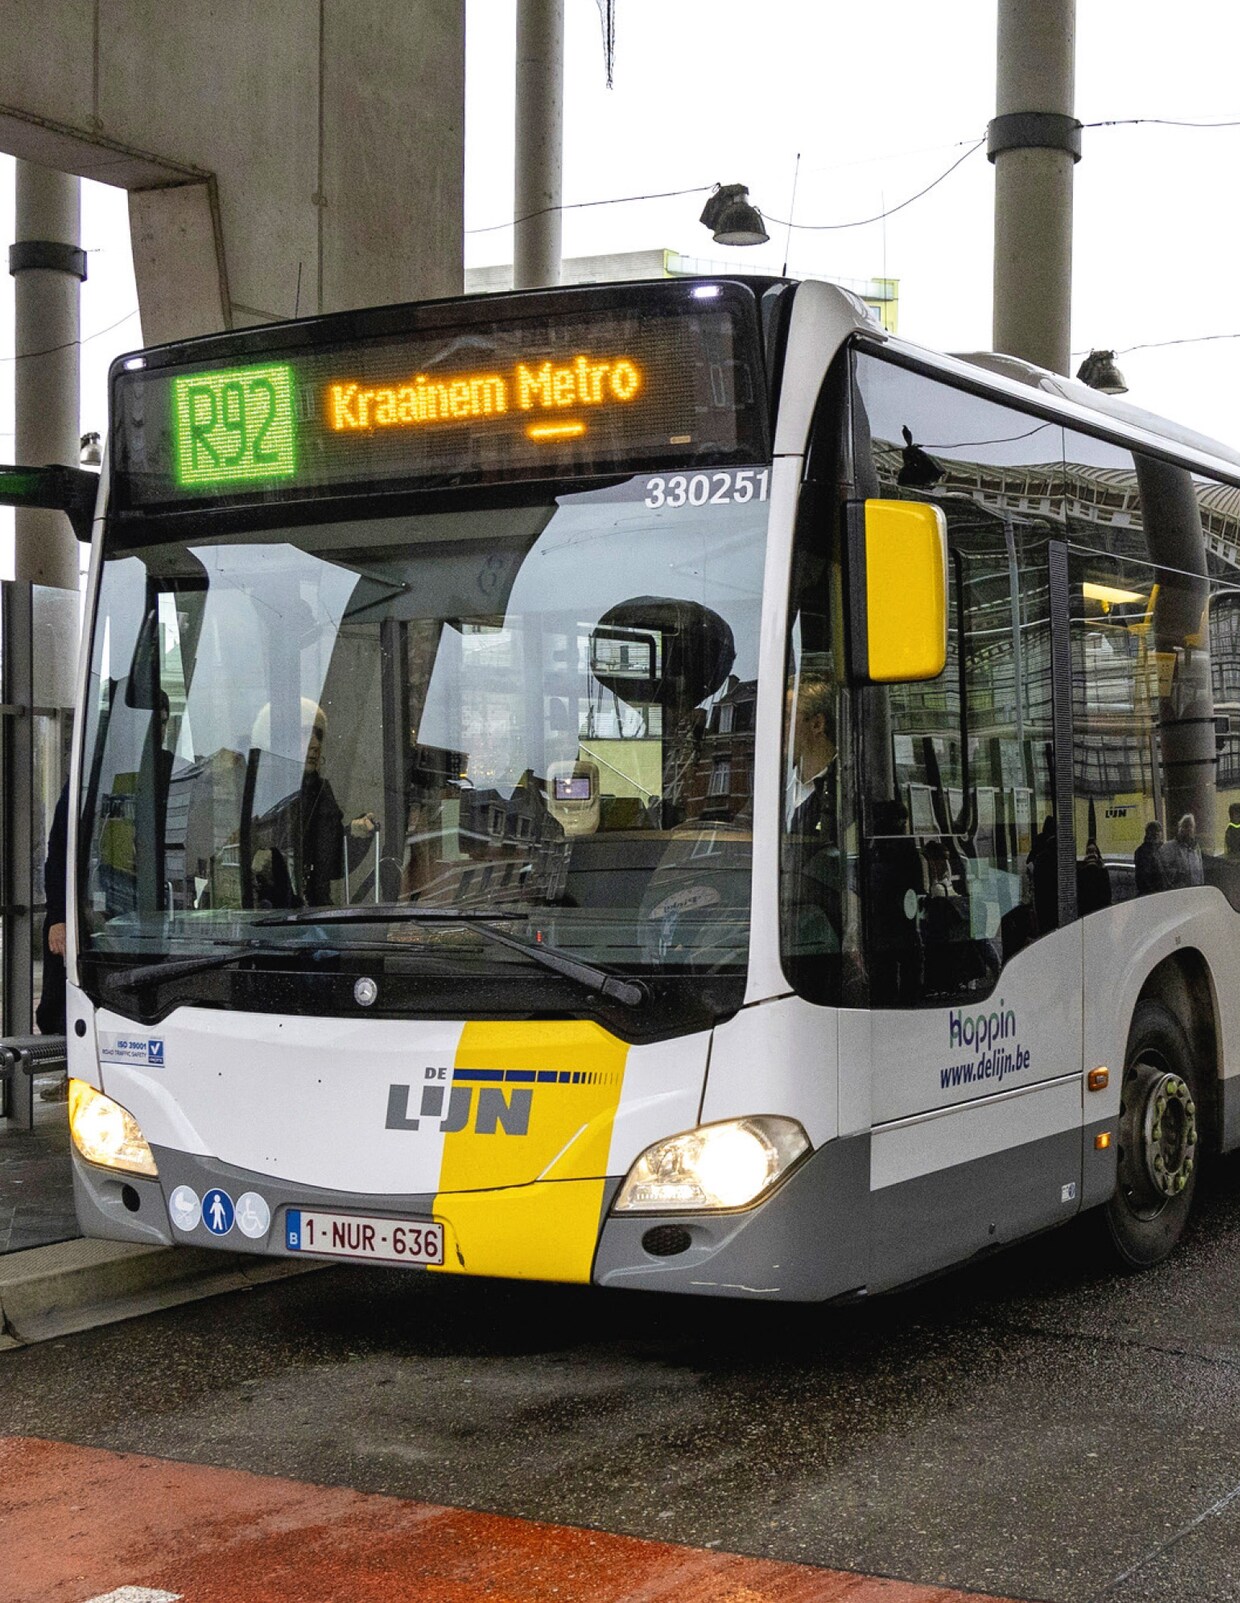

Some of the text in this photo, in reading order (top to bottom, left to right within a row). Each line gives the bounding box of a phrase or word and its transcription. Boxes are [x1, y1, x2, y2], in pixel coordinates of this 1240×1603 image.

[331, 355, 641, 430] Kraainem Metro
[187, 379, 281, 469] R92
[645, 469, 769, 509] 330251
[949, 998, 1016, 1054] Hoppin
[424, 1067, 447, 1080] DE
[940, 1044, 1031, 1089] www.delijn.be
[385, 1084, 533, 1136] LIJN
[289, 1219, 438, 1257] B 1-NUR-636
